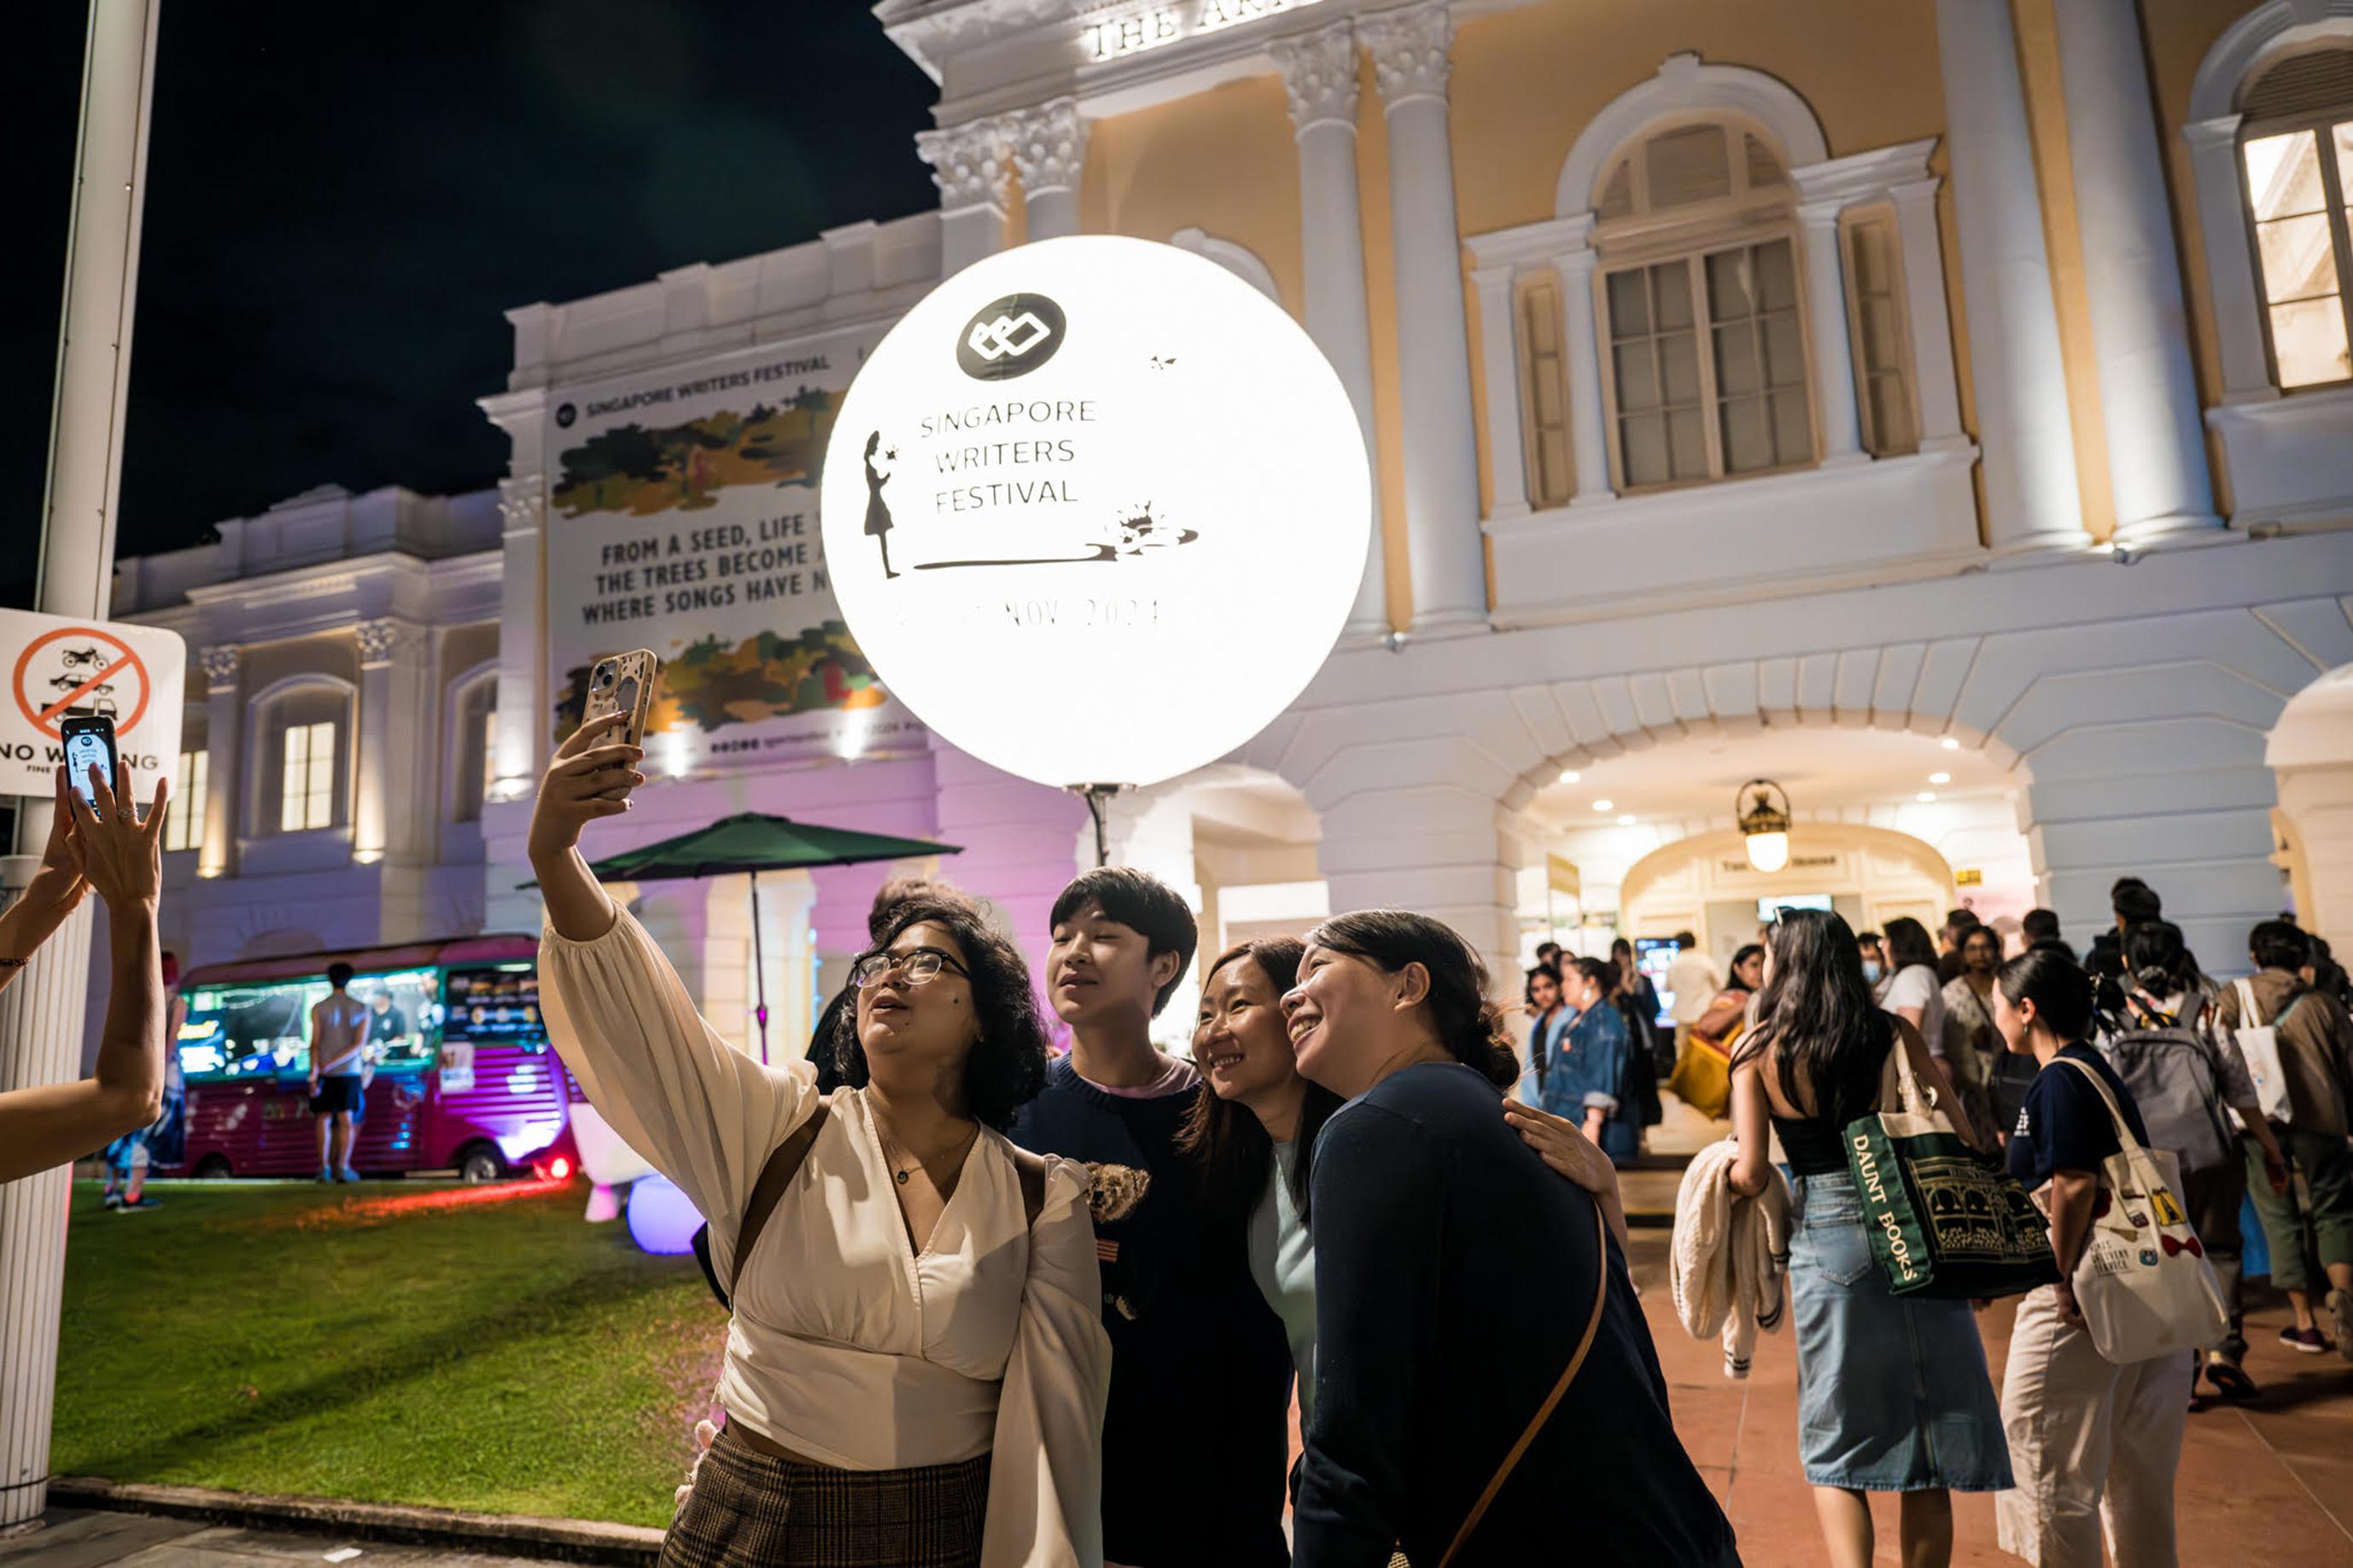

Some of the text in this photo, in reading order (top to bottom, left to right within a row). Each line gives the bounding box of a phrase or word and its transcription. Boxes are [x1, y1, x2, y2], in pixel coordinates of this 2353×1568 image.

[1082, 12, 1177, 56] THE
[586, 355, 831, 418] SINGAPORE WRITERS FESTIVAL
[920, 400, 1096, 439] SINGAPORE
[935, 439, 1076, 474] WRITERS
[935, 480, 1078, 514] FESTIVAL
[601, 513, 805, 566] FROM A SEED, LIFE
[594, 543, 809, 596] THE TREES BECOME
[581, 595, 656, 627] WHERE
[665, 582, 736, 614] SONGS
[746, 573, 803, 603] HAVE
[1852, 1134, 1918, 1282] DAUNT BOOKS
